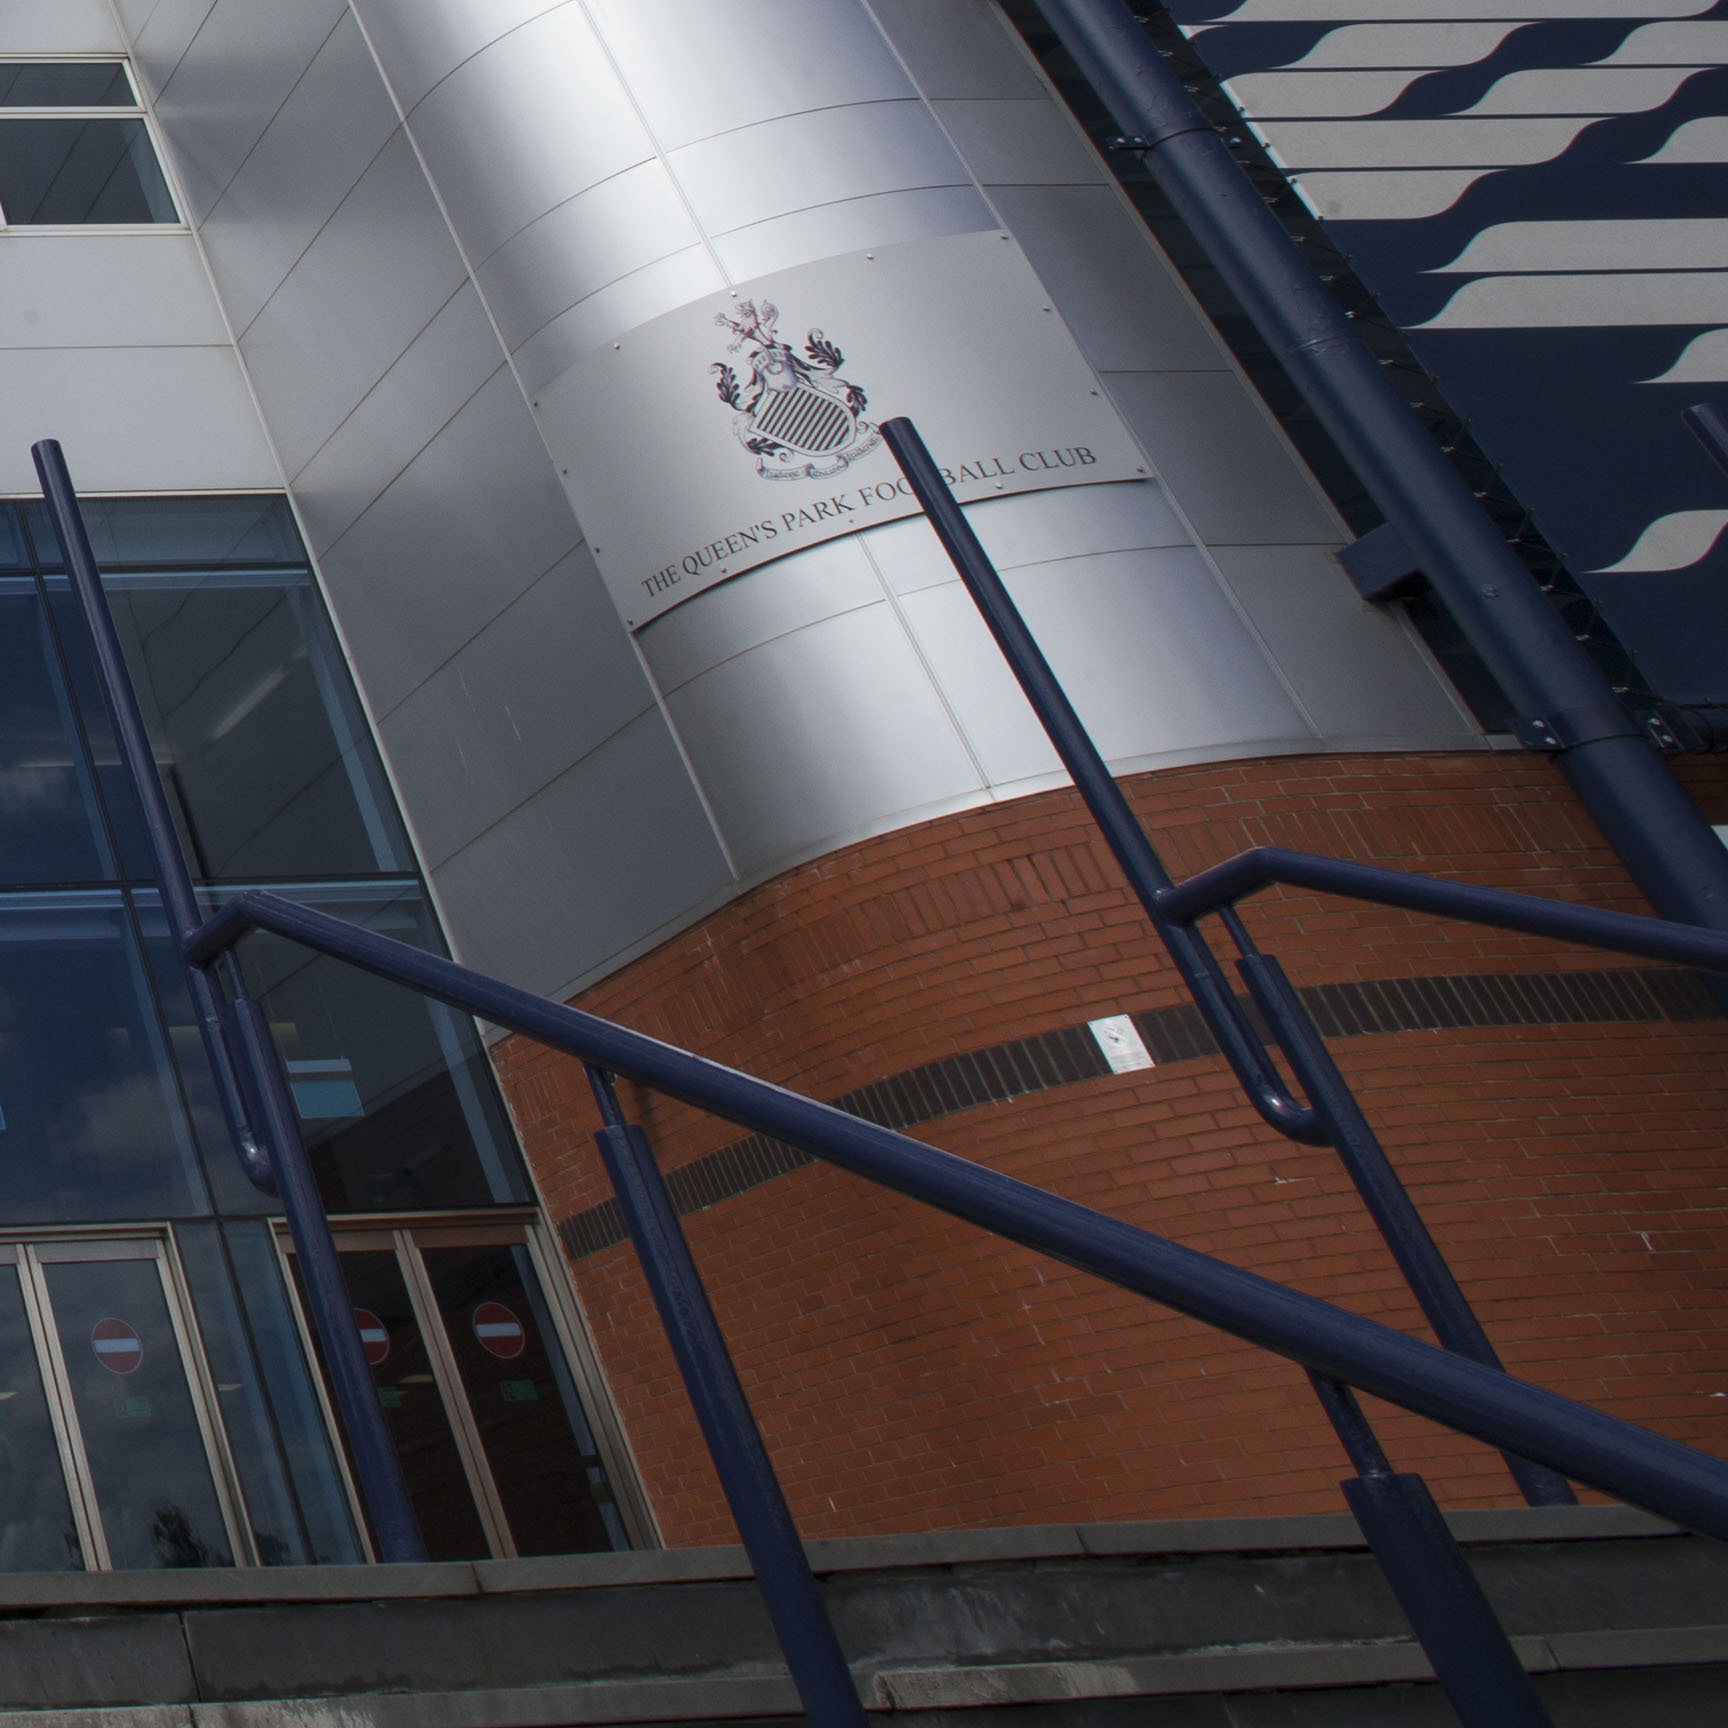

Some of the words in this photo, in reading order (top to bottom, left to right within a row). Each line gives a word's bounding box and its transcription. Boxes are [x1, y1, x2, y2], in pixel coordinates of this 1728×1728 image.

[641, 564, 682, 598] THE
[681, 519, 779, 577] QUEEN'S
[781, 493, 856, 532] PARK
[857, 456, 1016, 507] FOOBALL
[1018, 445, 1097, 469] CLUB
